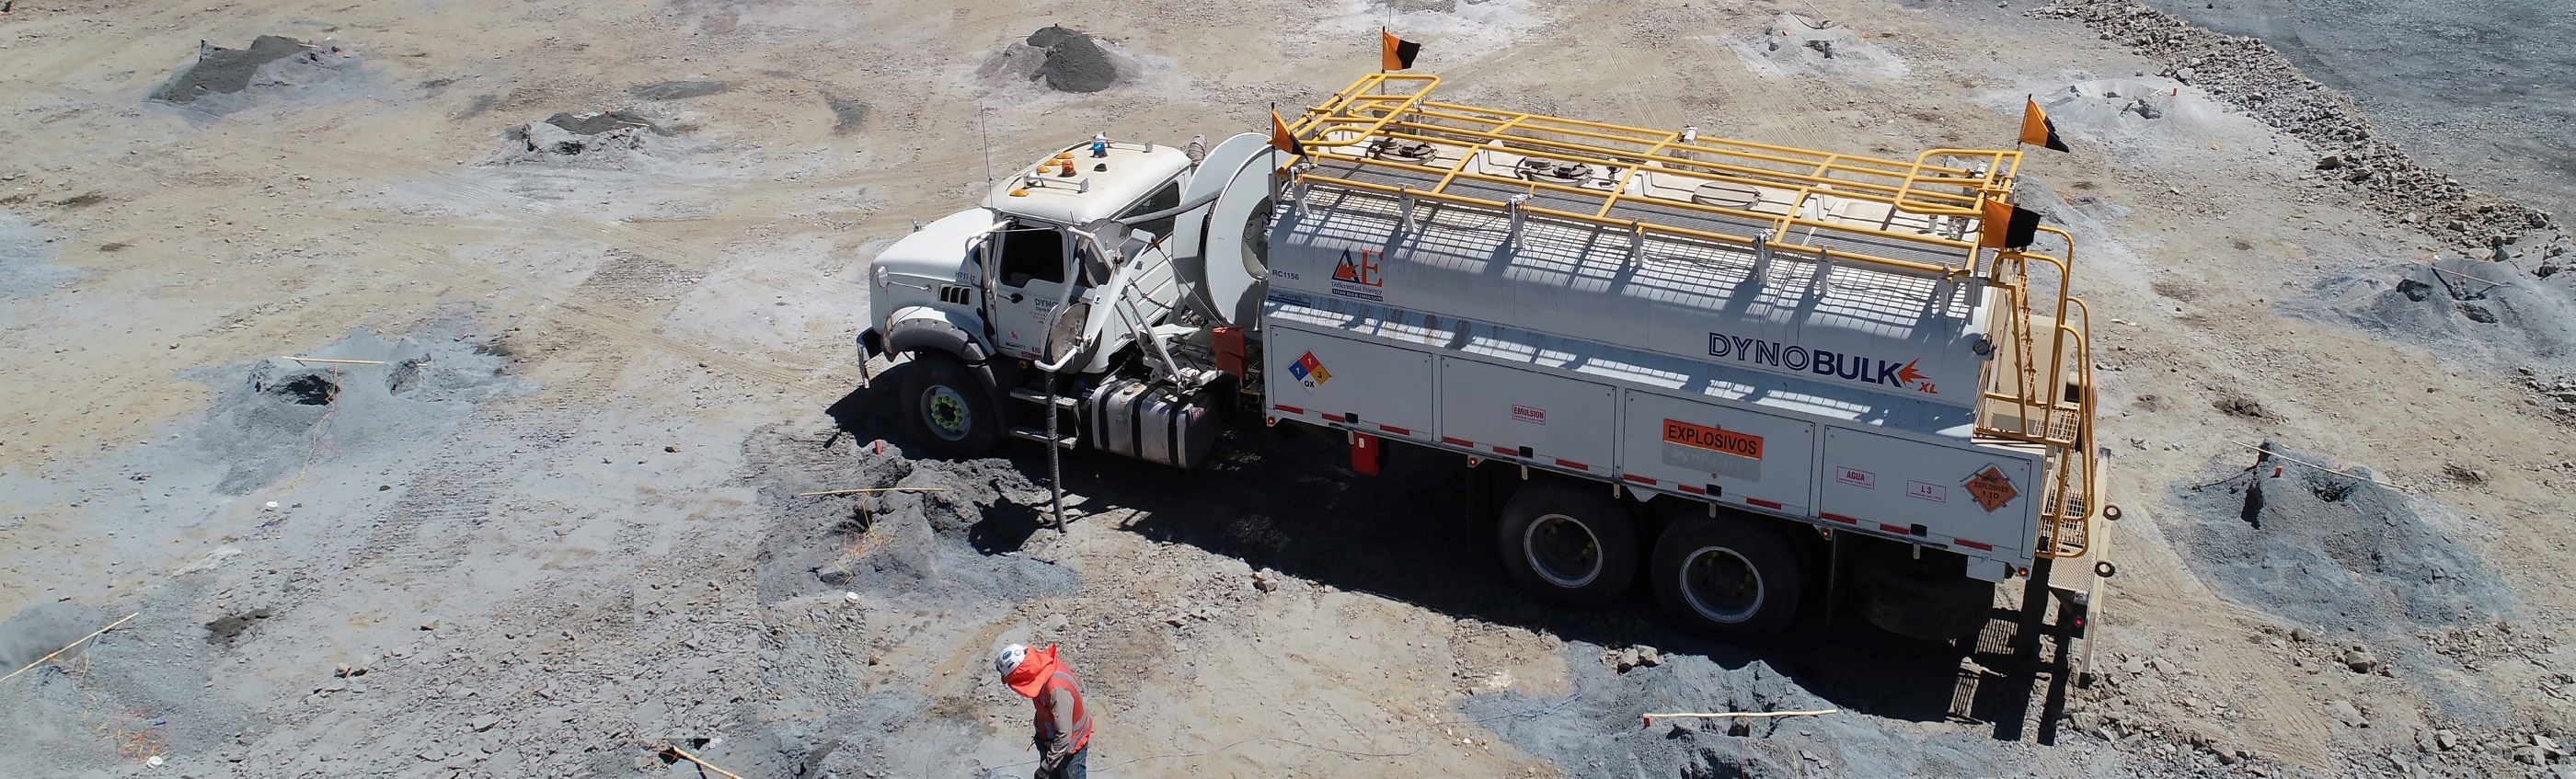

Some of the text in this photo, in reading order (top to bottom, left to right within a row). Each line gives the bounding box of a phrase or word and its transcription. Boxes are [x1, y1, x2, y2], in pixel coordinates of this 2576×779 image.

[955, 271, 975, 281] HT177
[1272, 269, 1299, 280] RC1156
[1331, 281, 1383, 295] Differential Energy
[1708, 332, 1938, 394] DYNOBULK XL
[1514, 407, 1544, 419] EMULSION
[1668, 425, 1757, 455] EXPLOSIVOS
[1846, 471, 1865, 482] AGUA
[1974, 481, 2008, 493] EXPLOSIVES
